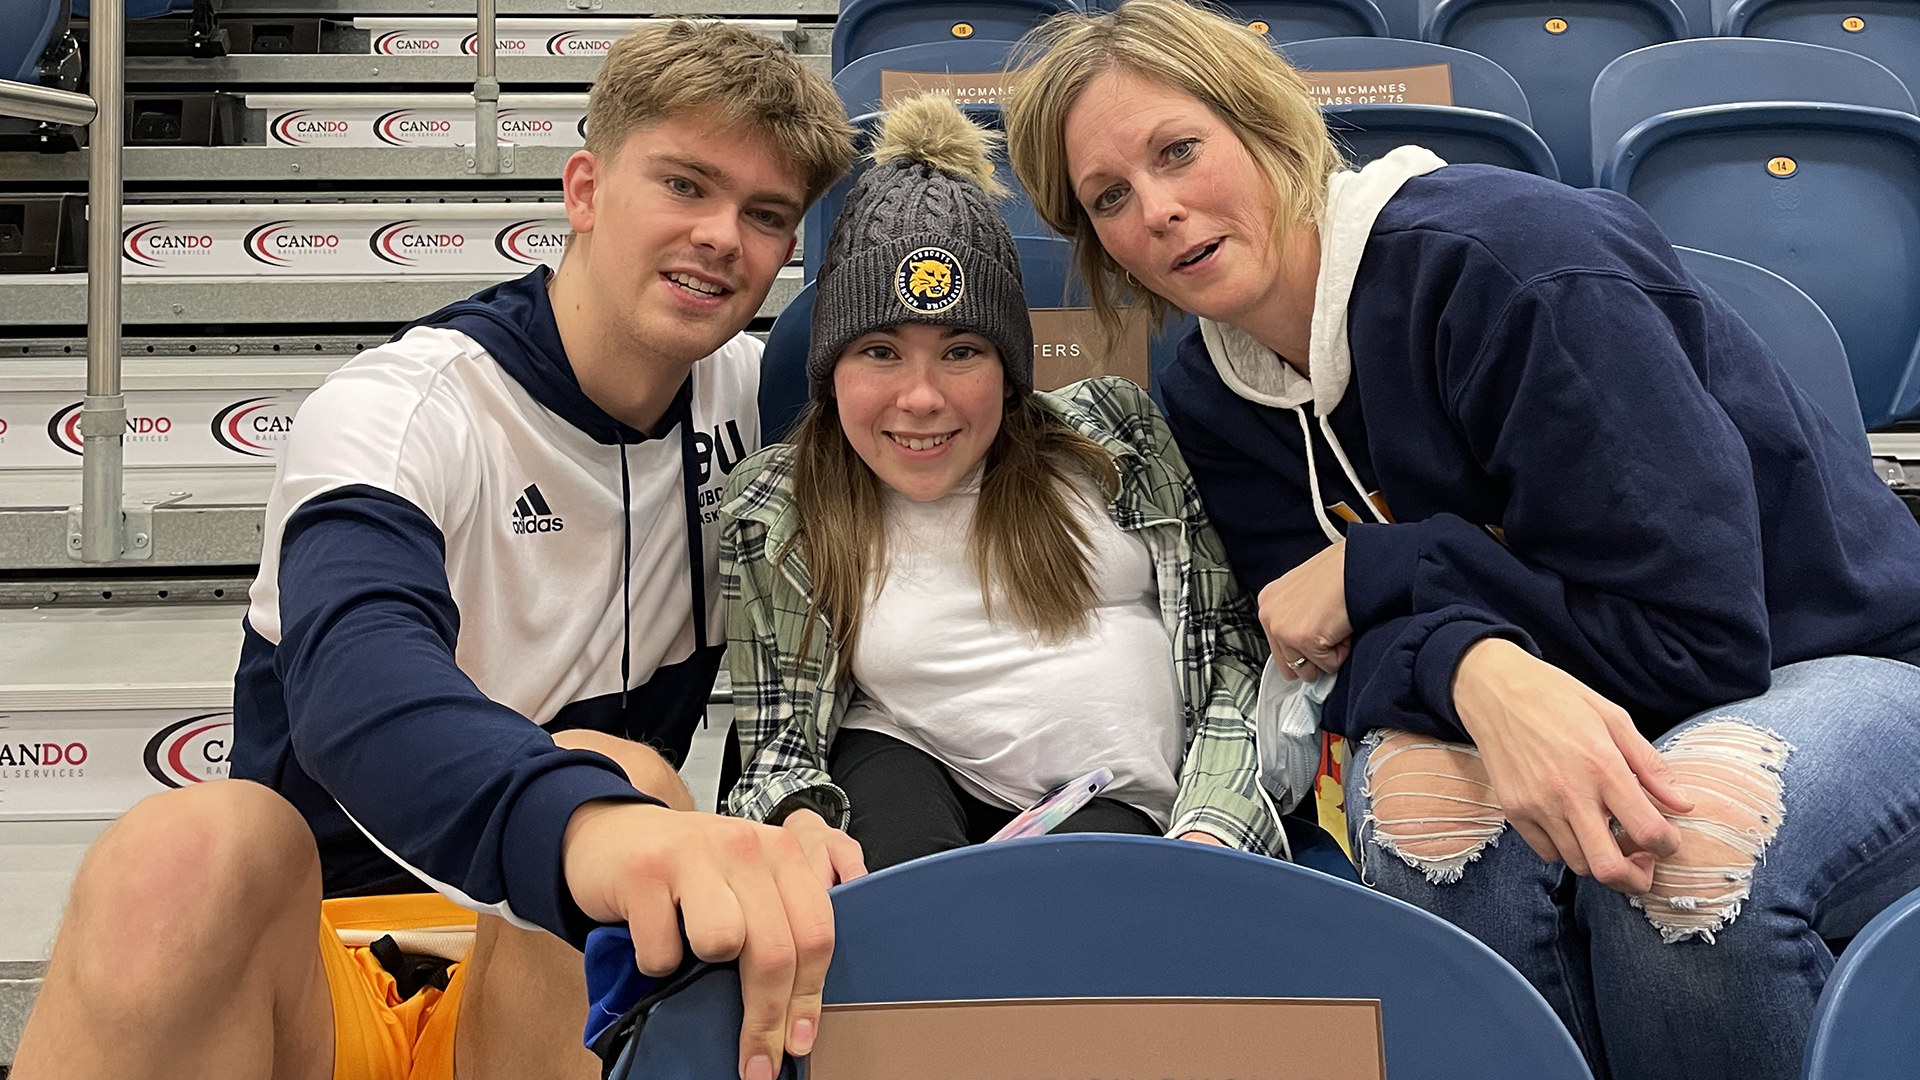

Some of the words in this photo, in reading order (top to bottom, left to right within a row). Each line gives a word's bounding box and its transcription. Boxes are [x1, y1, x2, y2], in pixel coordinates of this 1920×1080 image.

[1552, 22, 1560, 30] 14
[396, 40, 439, 50] CANDO
[568, 41, 611, 50] CANDO
[957, 85, 1015, 97] MCMANE
[1309, 86, 1331, 95] JIM
[1337, 83, 1407, 95] MCMANES
[1317, 96, 1352, 106] LASS
[1359, 96, 1377, 104] OF
[1383, 94, 1404, 103] '75
[297, 121, 348, 132] CANDO
[400, 121, 451, 131] CANDO
[502, 120, 553, 131] CANDO
[1776, 161, 1787, 171] 14
[150, 235, 213, 248] CANDO
[276, 234, 339, 248] CANDO
[402, 234, 465, 247] CANDO
[512, 515, 564, 535] adidas
[15, 768, 84, 778] SERVICES
